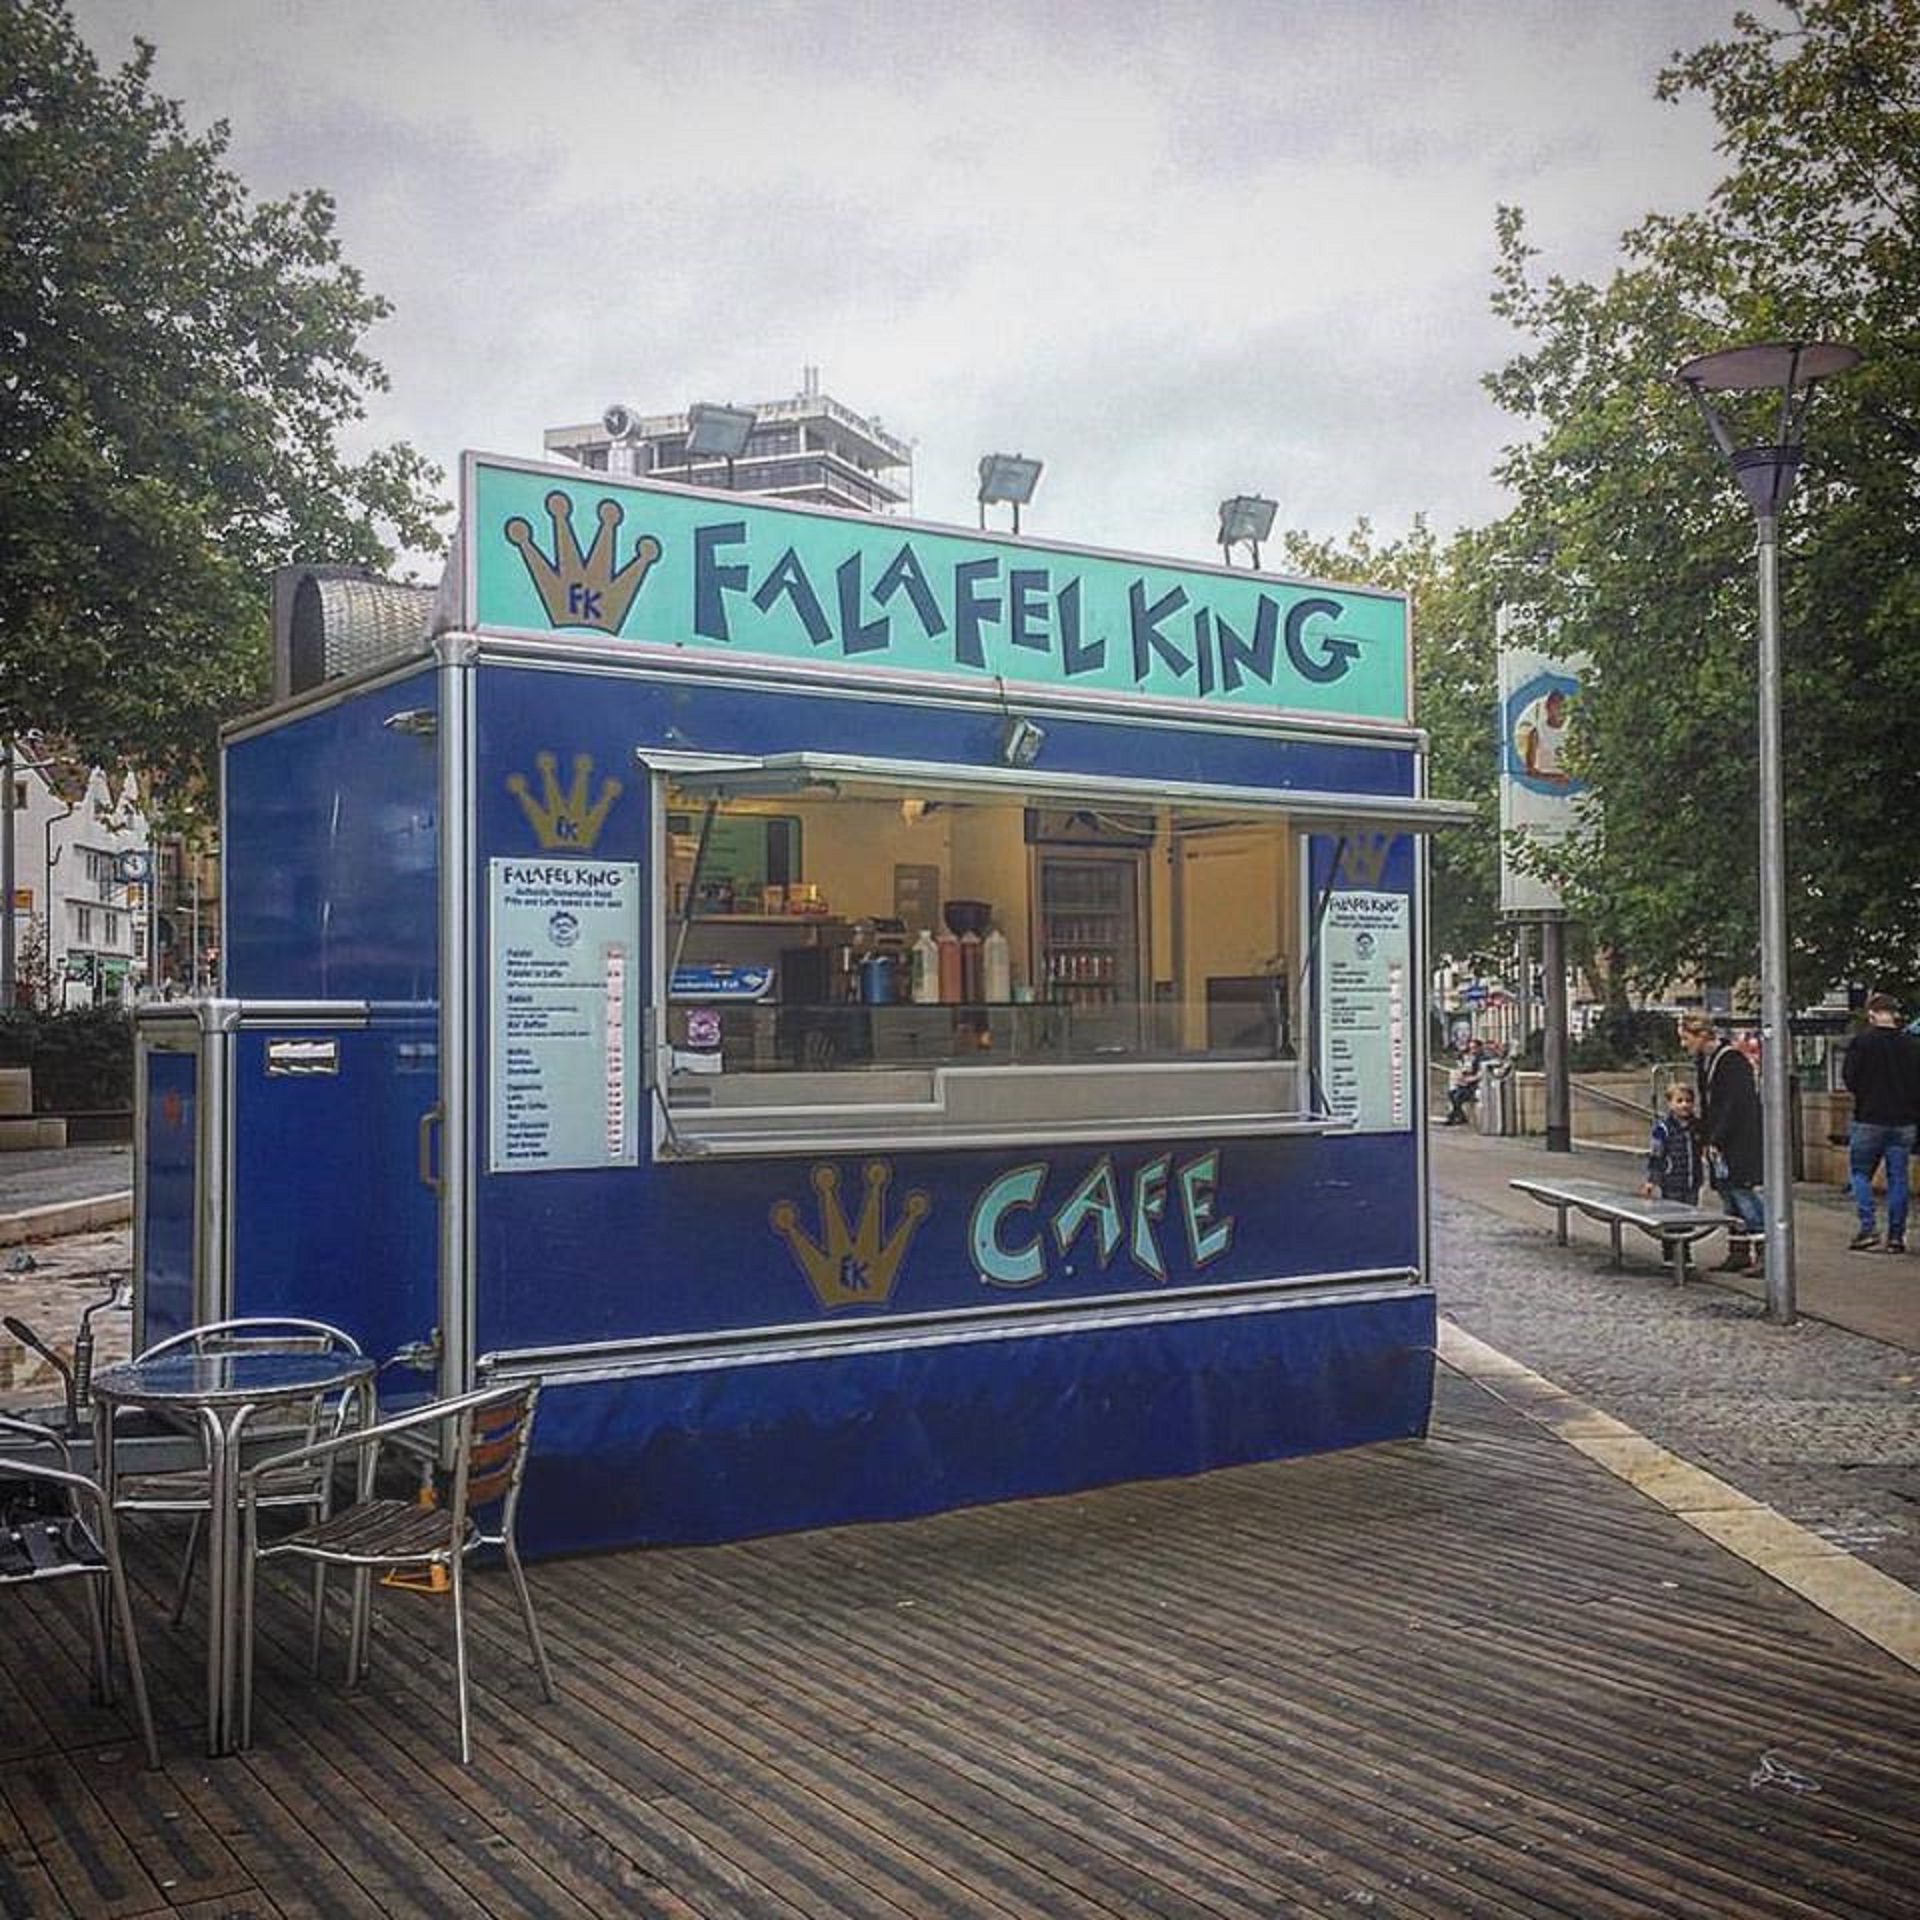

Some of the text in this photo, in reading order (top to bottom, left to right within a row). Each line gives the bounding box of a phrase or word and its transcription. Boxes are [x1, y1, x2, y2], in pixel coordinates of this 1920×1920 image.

[569, 582, 602, 619] FK
[694, 520, 1361, 697] FALAFEL KING
[503, 866, 623, 887] FALAFEL KING
[969, 1151, 1233, 1286] CAFE
